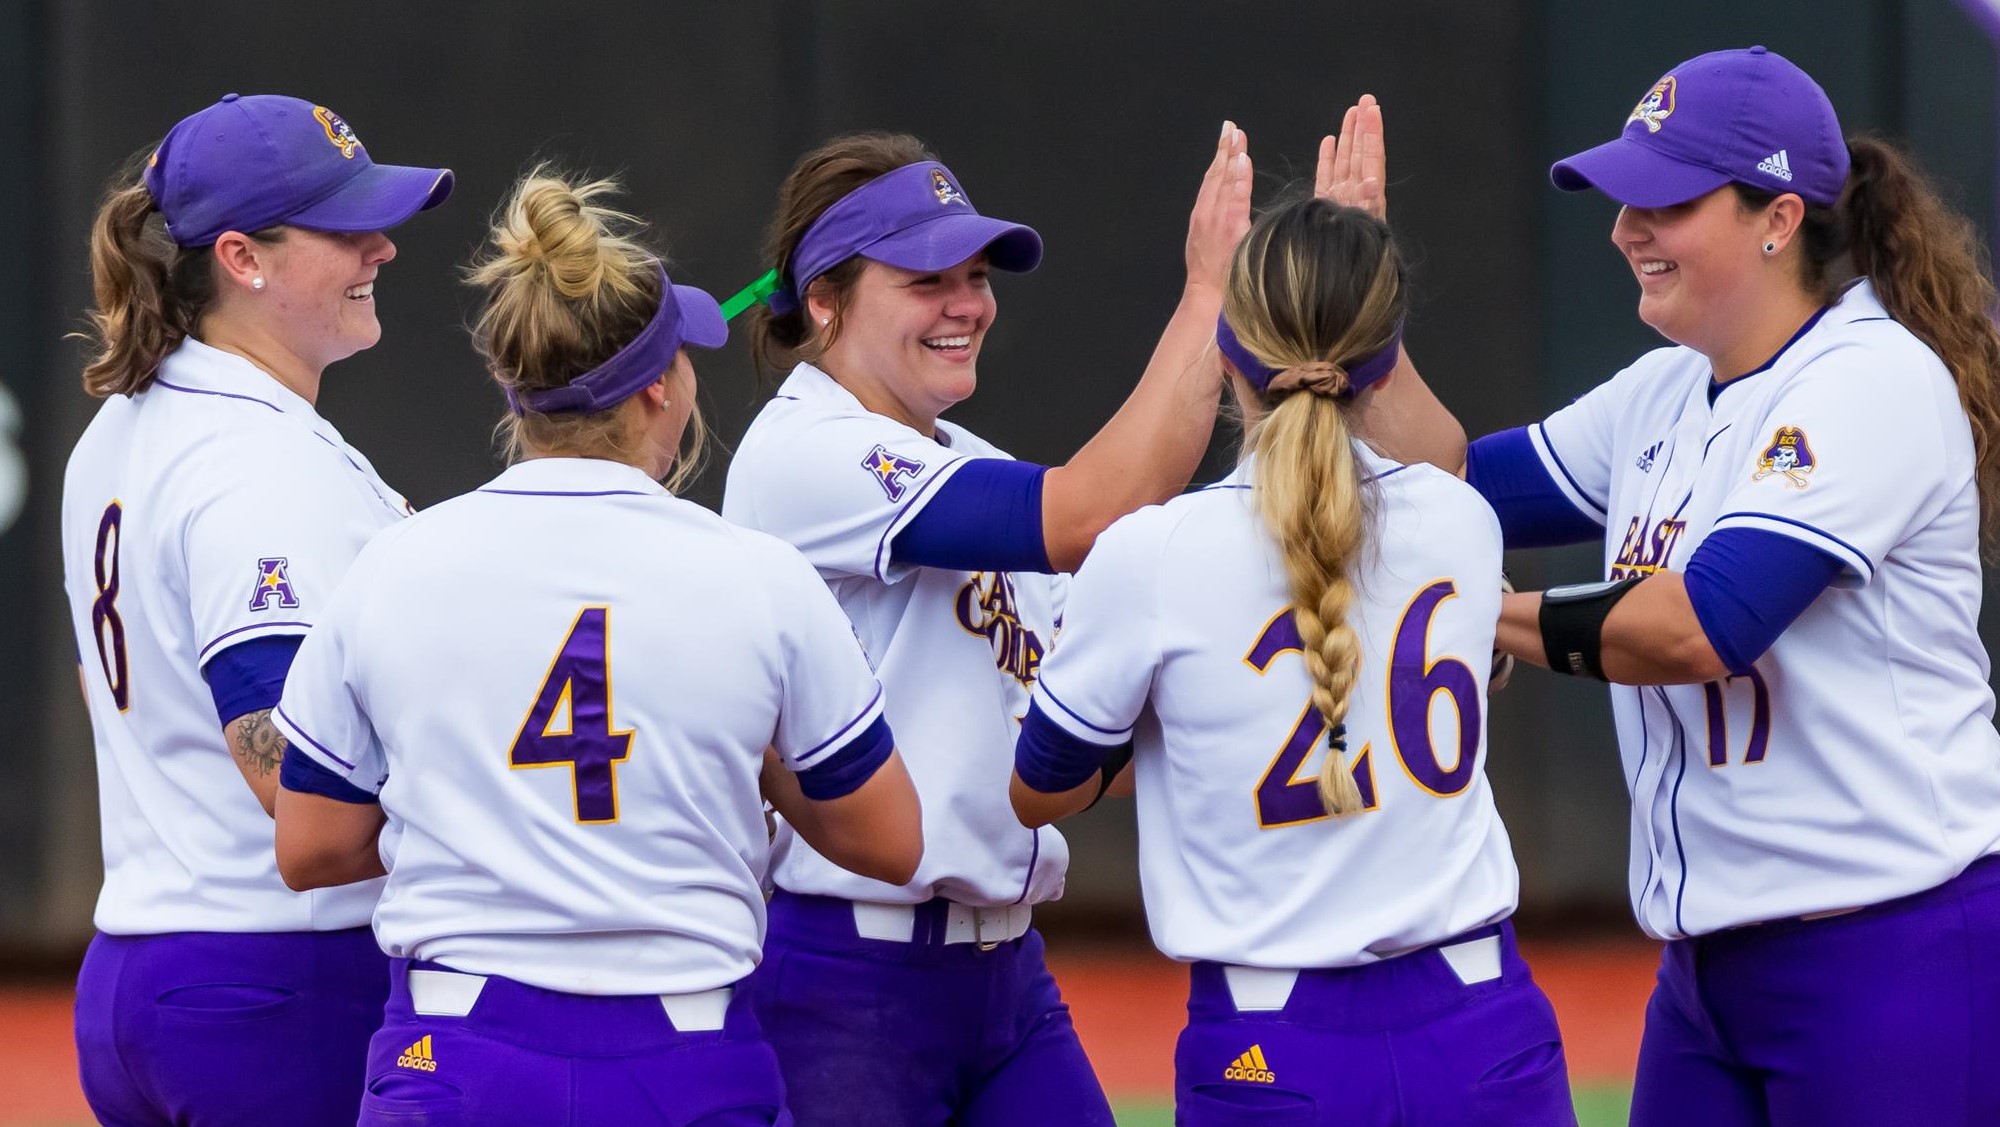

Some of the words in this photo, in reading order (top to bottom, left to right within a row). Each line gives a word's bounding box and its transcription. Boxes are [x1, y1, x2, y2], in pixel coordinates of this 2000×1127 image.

[1757, 161, 1792, 181] adidas
[861, 444, 926, 503] A
[1612, 515, 1687, 570] EAST
[92, 498, 129, 714] 8
[249, 557, 299, 612] A
[508, 604, 636, 824] 4
[1242, 577, 1481, 830] 26
[1702, 665, 1771, 769] 17
[397, 1055, 437, 1072] adidas
[1224, 1066, 1276, 1083] adidas
